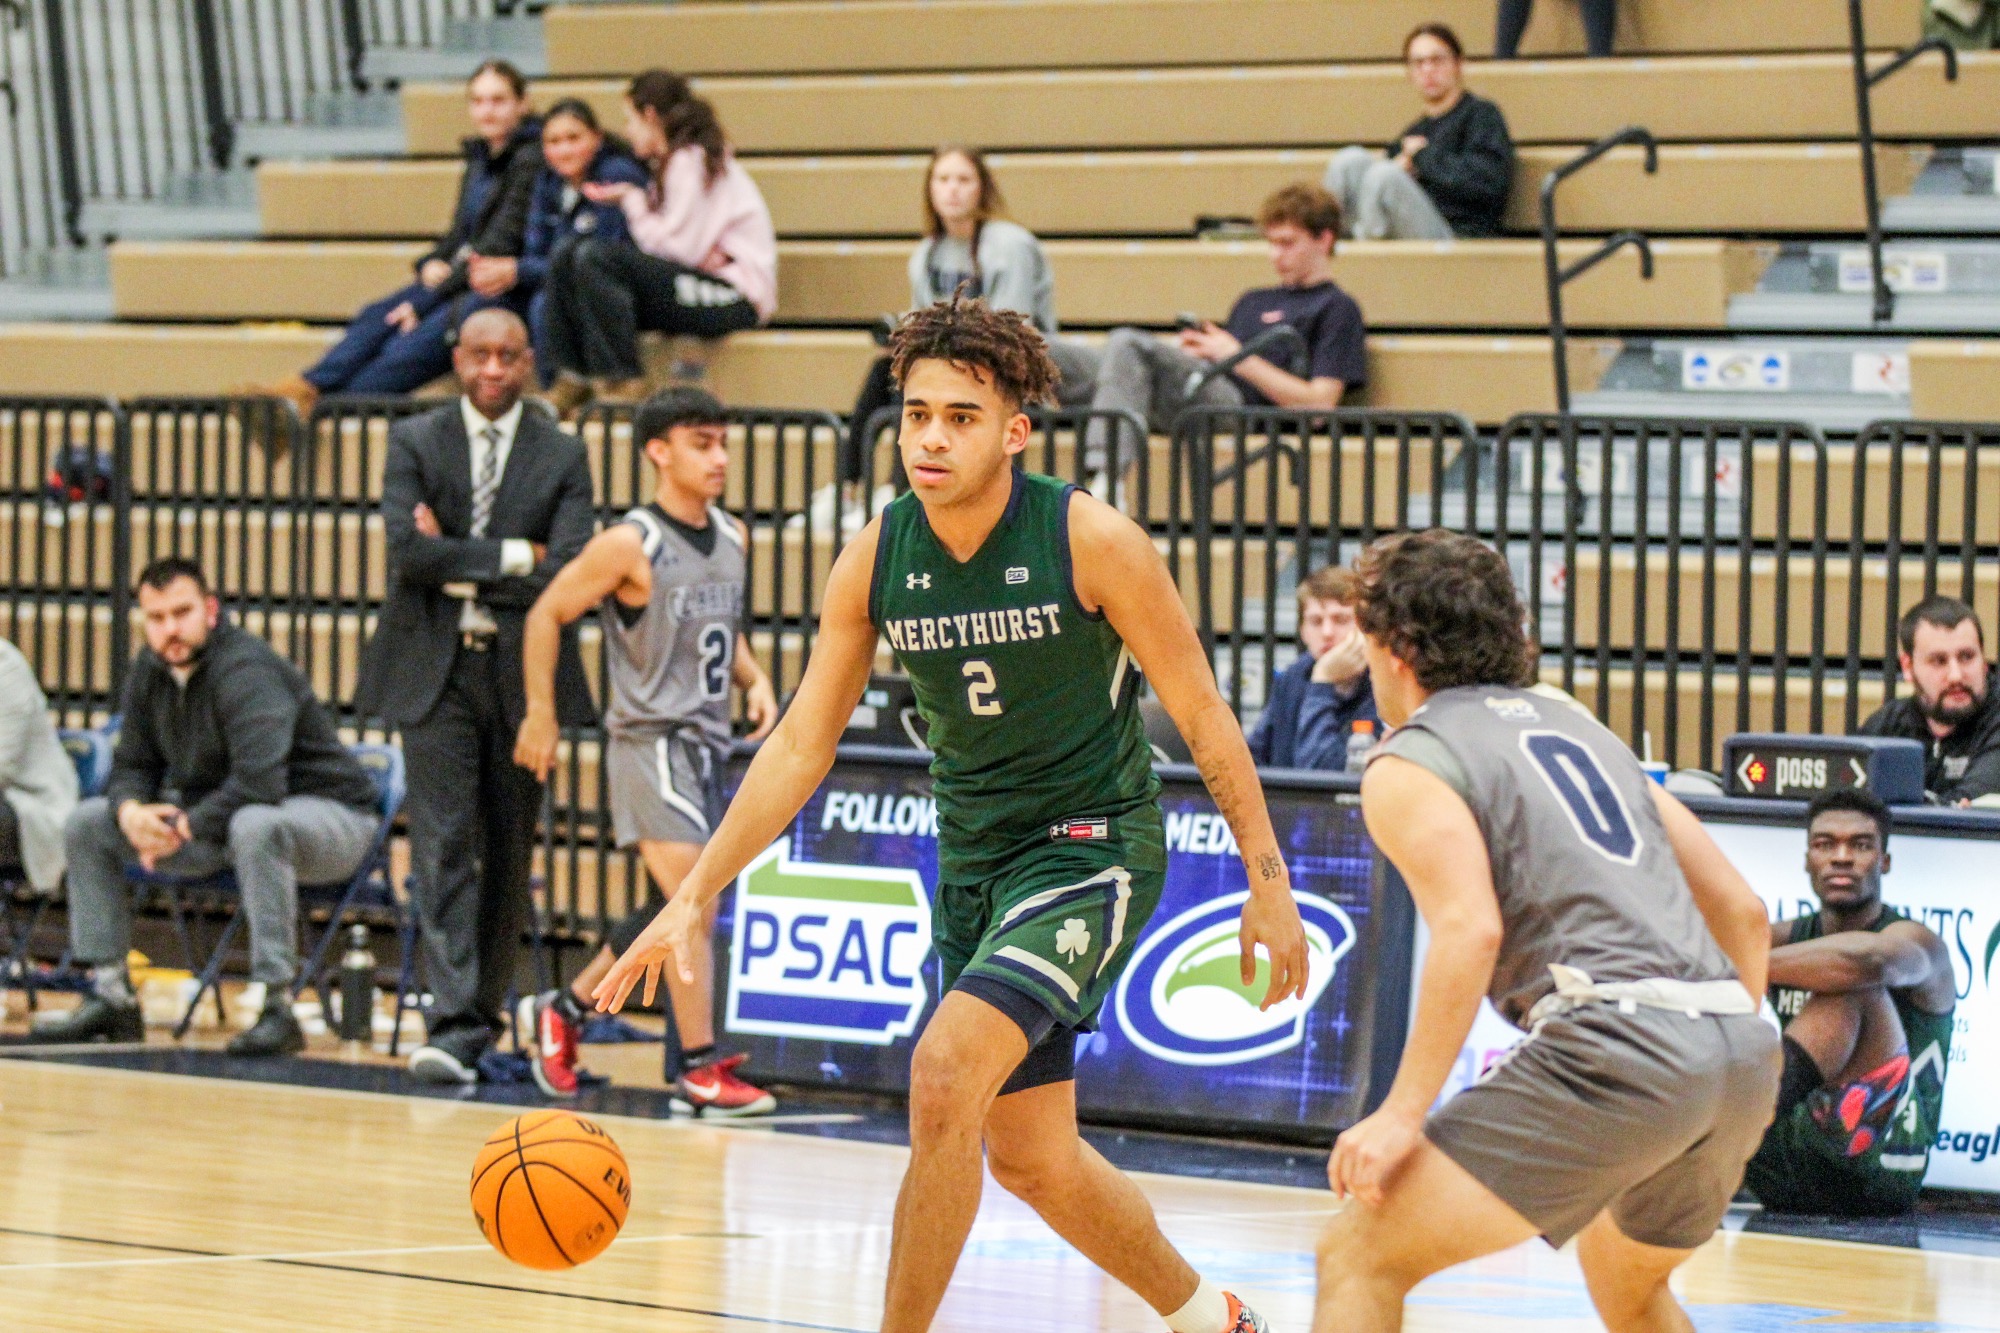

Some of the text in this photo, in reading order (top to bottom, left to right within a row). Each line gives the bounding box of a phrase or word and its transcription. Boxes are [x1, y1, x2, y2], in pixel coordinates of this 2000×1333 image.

[886, 604, 1062, 651] MERCYHURST
[699, 623, 732, 701] 2
[962, 661, 1003, 715] 2
[1519, 730, 1644, 866] 0
[1261, 864, 1281, 881] 937
[740, 910, 918, 988] PSAC
